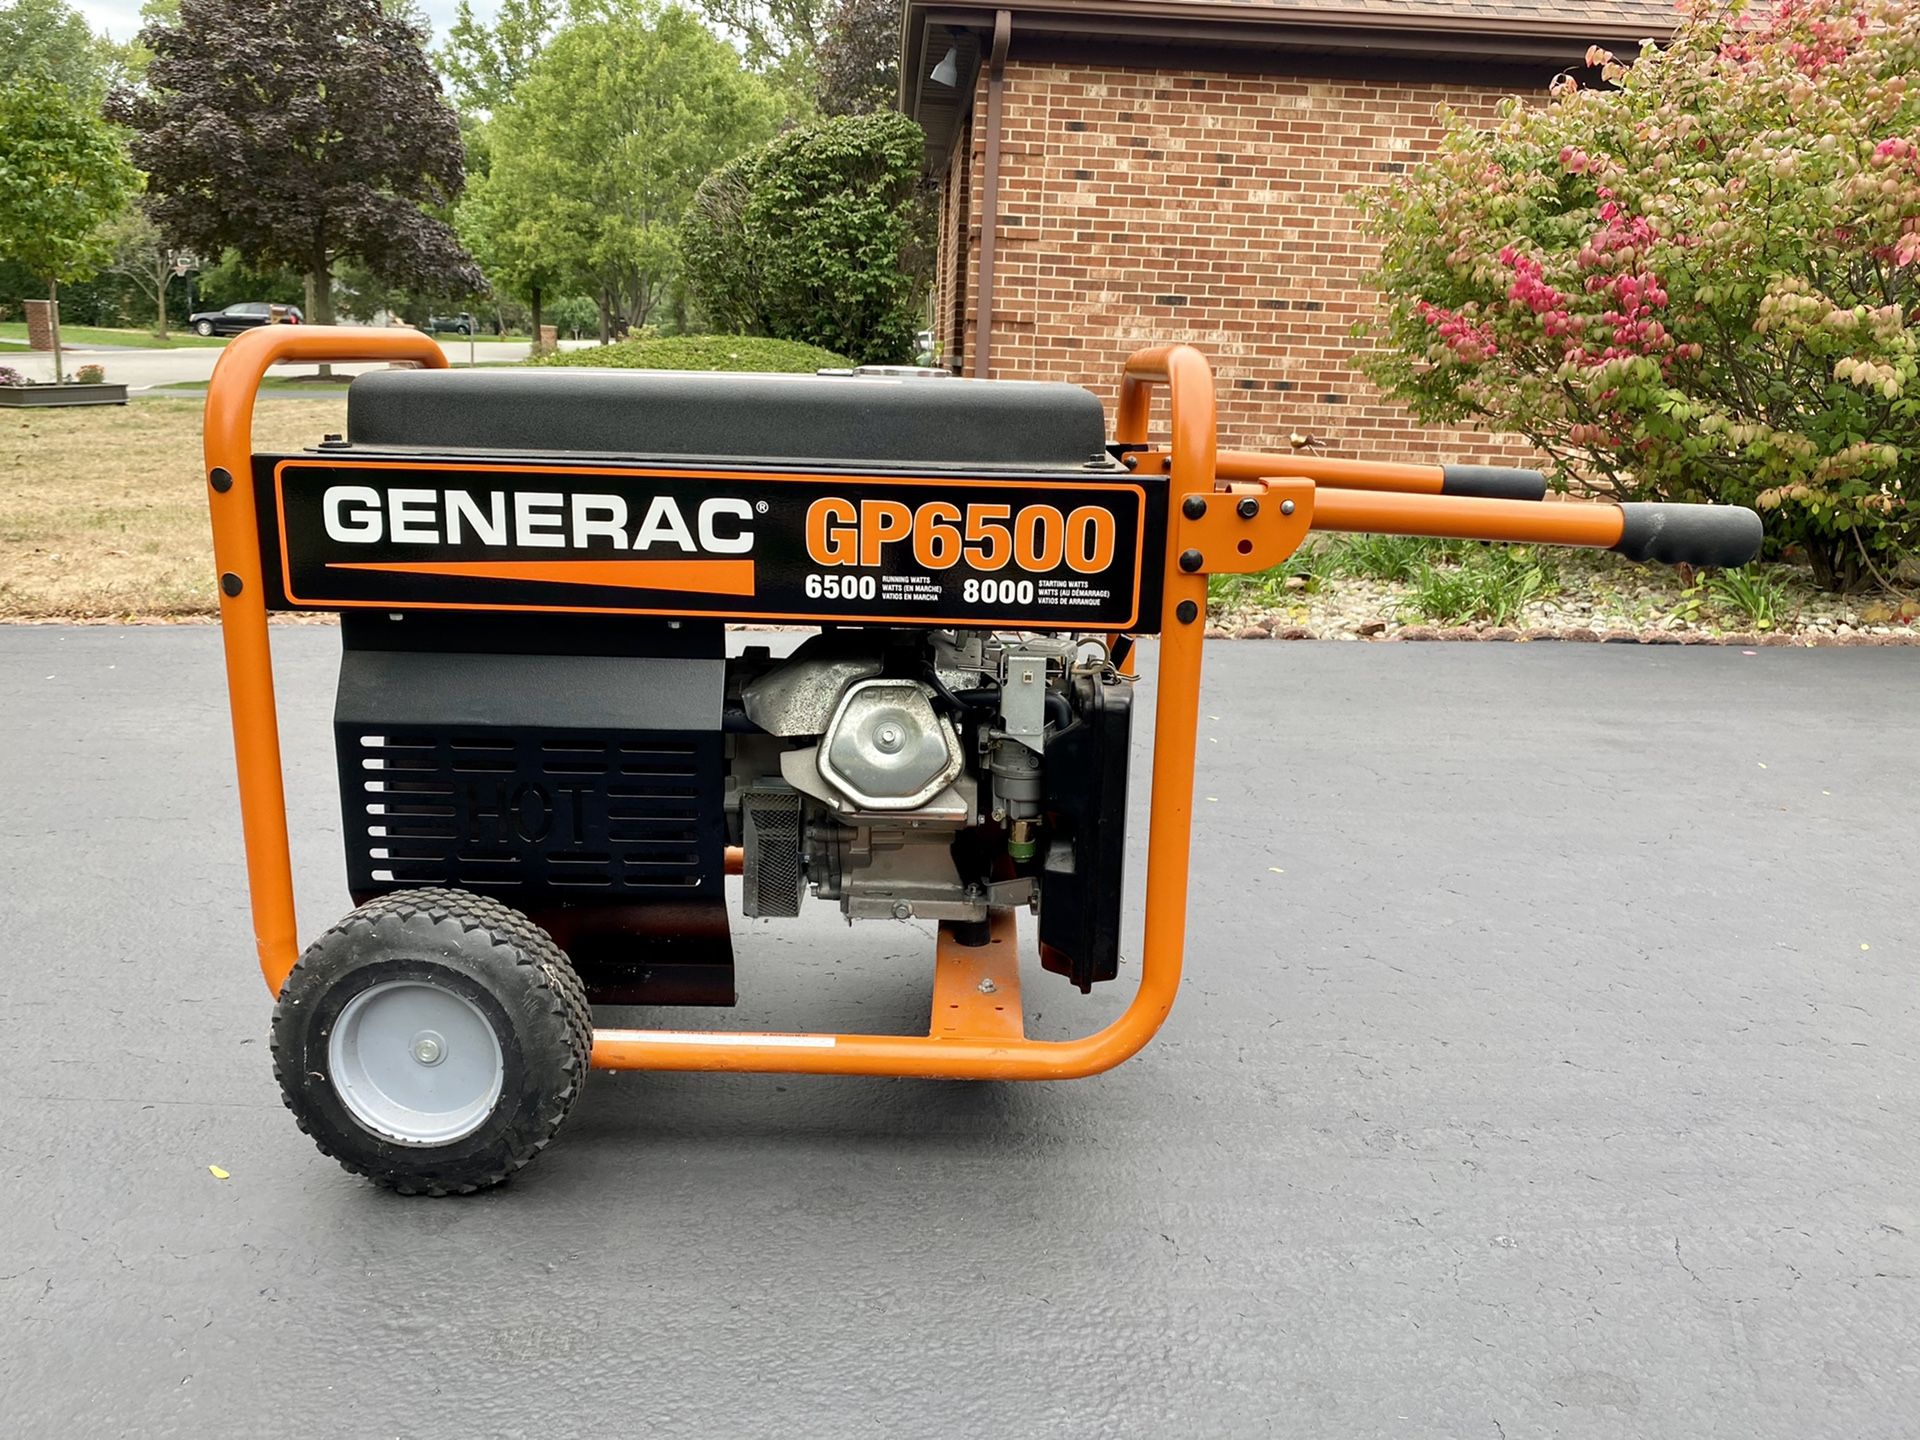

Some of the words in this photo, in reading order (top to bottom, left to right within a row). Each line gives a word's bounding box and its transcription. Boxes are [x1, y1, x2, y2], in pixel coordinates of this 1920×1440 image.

[805, 497, 1116, 574] GP6500
[882, 575, 909, 583] RUNNING
[910, 576, 931, 584] WATTS
[1038, 580, 1067, 588] STARTING
[805, 574, 876, 600] 6500
[882, 592, 903, 600] VATIOS
[913, 593, 939, 601] MARCHA
[963, 579, 1034, 605] 8000
[1038, 588, 1059, 596] WATTS
[1038, 597, 1059, 605] VATIOS
[1060, 597, 1068, 605] DE
[1069, 598, 1101, 606] ARRANQUE
[463, 782, 594, 844] HOT
